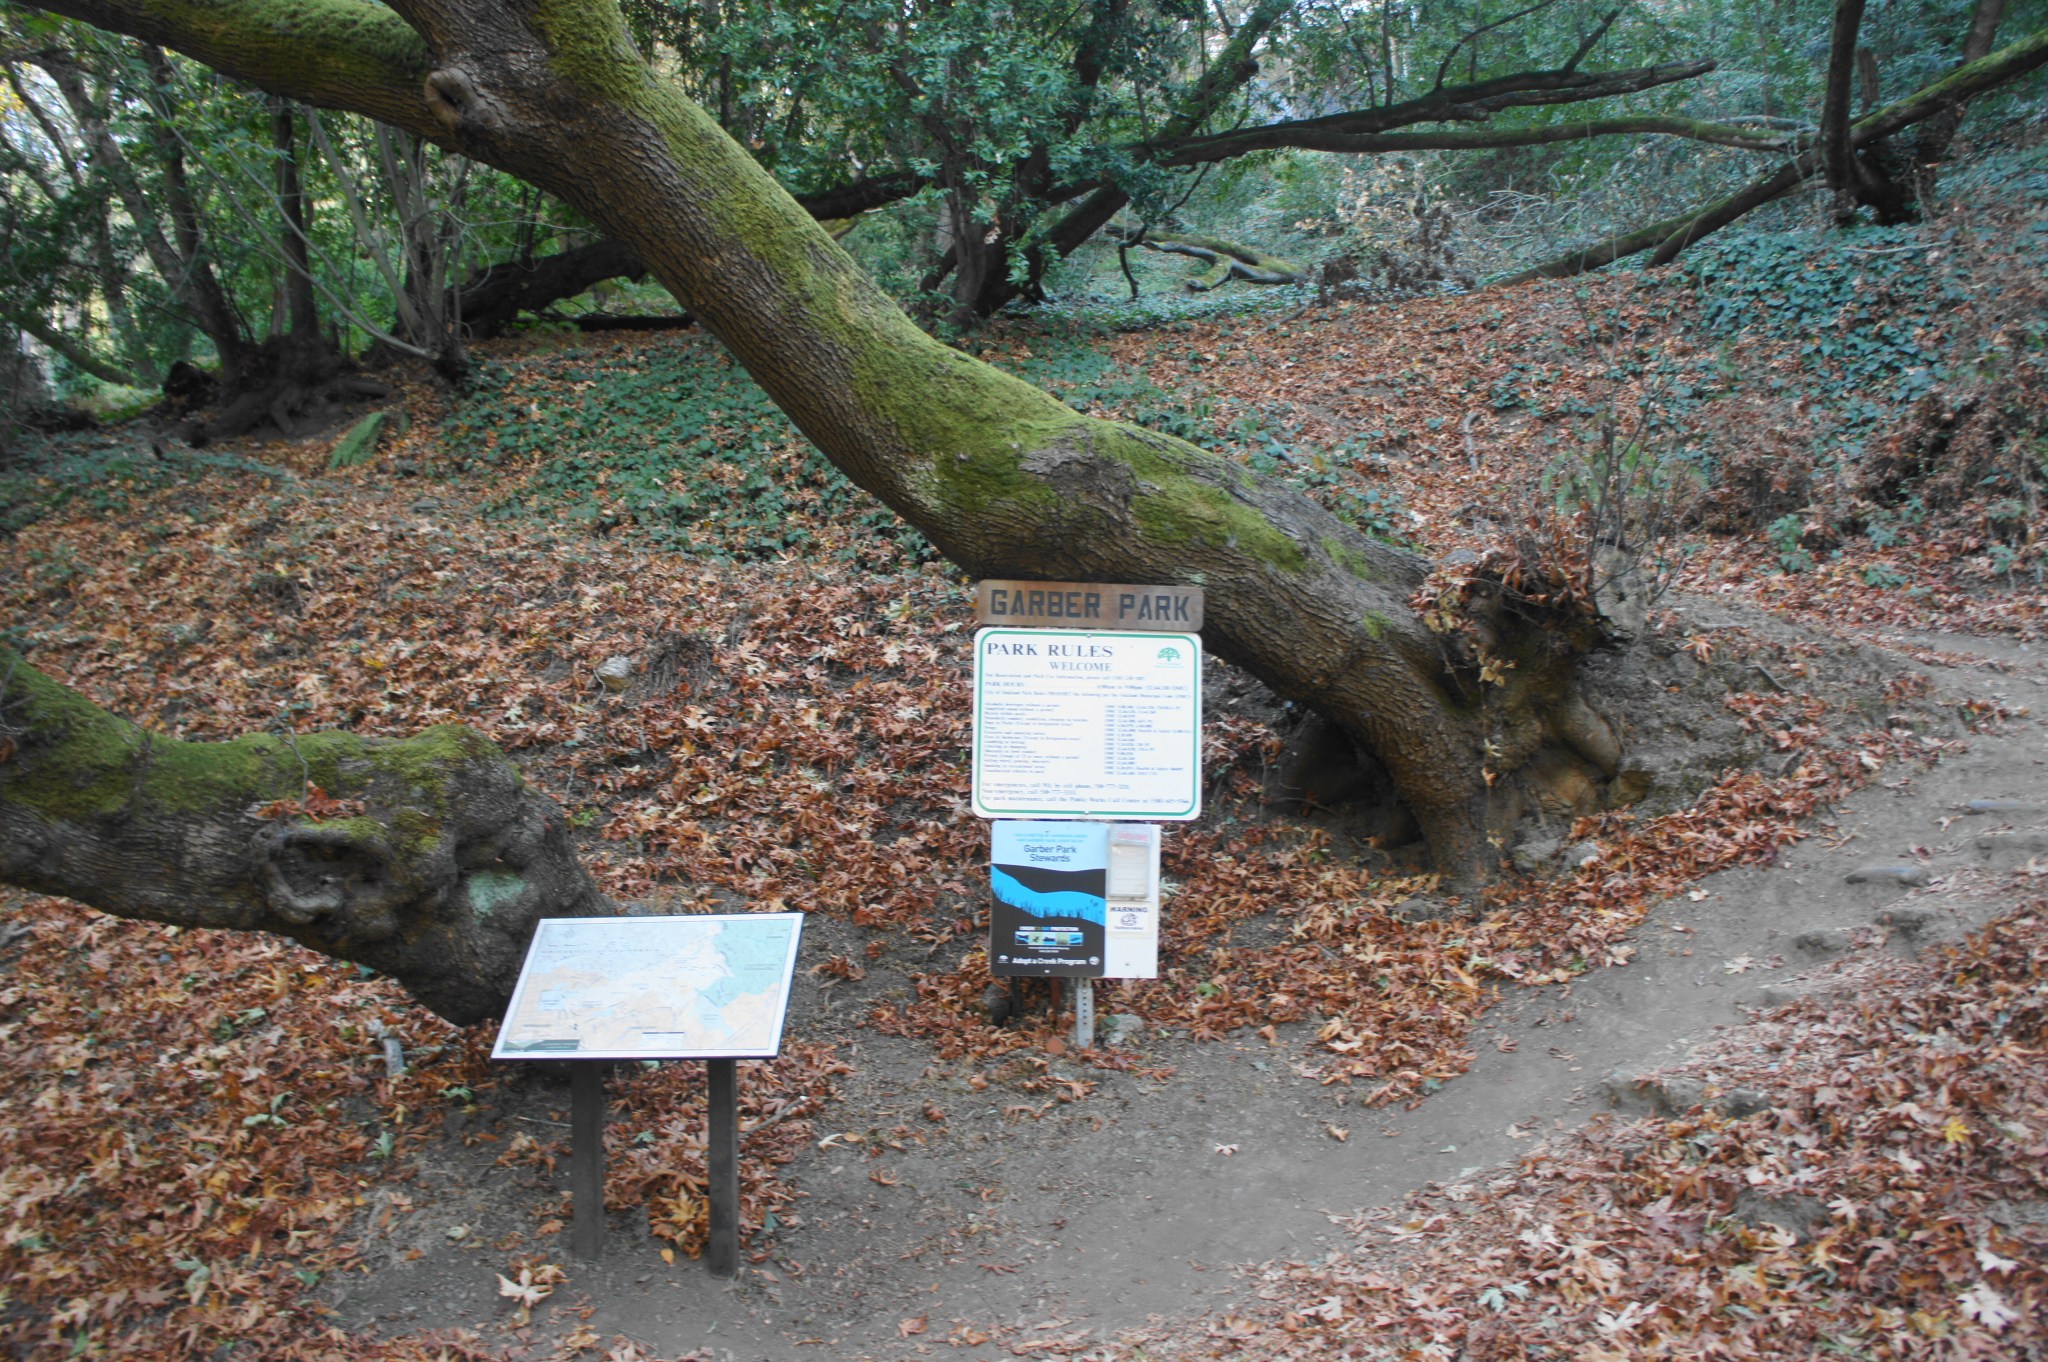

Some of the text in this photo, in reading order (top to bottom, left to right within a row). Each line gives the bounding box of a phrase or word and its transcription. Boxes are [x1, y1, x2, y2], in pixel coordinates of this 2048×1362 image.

[990, 588, 1190, 622] GARBER PARK
[986, 642, 1114, 658] PARK RULES
[1049, 661, 1112, 672] WELCOME
[1024, 844, 1077, 854] Garber Park
[1029, 854, 1071, 863] Stewards
